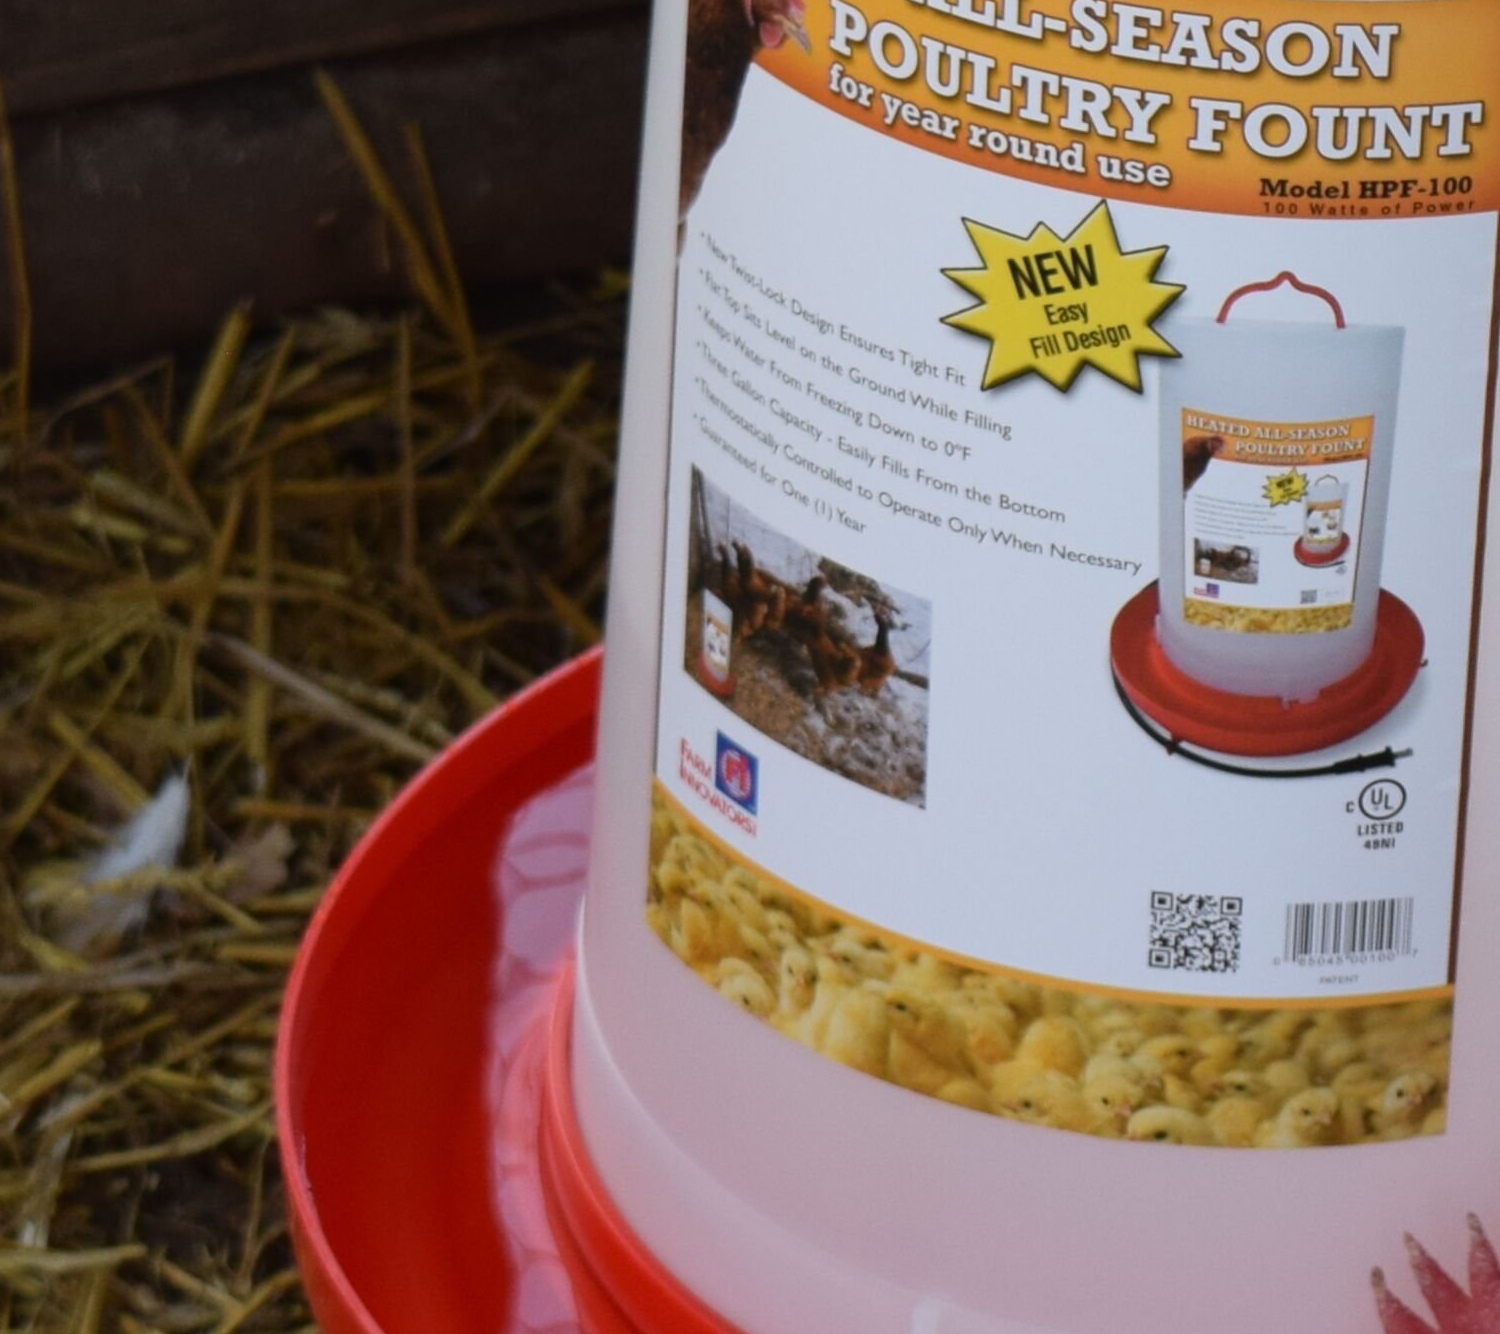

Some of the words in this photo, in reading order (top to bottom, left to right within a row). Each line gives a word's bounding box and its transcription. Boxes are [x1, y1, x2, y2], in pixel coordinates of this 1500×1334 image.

[829, 63, 874, 107] for
[880, 92, 960, 140] year
[968, 124, 1086, 174] round
[1097, 154, 1172, 187] use
[1188, 100, 1484, 161] FOUNT
[1259, 178, 1350, 199] Model
[1358, 176, 1473, 199] HPF-100
[1263, 202, 1298, 215] 100
[1310, 203, 1369, 216] Watts
[1381, 202, 1402, 215] of
[1412, 200, 1477, 214] Power
[1007, 244, 1098, 300] NEW
[1043, 302, 1089, 325] Easy
[723, 286, 741, 315] Top
[766, 320, 796, 349] Level
[800, 345, 817, 362] on
[821, 355, 844, 376] the
[848, 367, 906, 403] Ground
[910, 391, 958, 421] While
[964, 410, 1012, 441] Filling
[730, 254, 787, 307] Twist-Lock
[791, 299, 834, 334] Design
[840, 324, 895, 362] Ensures
[899, 349, 939, 376] Tight
[945, 367, 966, 386] Fit
[1029, 333, 1062, 359] Fill
[1063, 324, 1131, 352] Design
[732, 333, 767, 367] Water
[770, 359, 802, 390] From
[806, 382, 863, 427] Freezing
[868, 412, 915, 443] Down
[921, 436, 938, 452] to
[699, 416, 758, 474] Guaranteed
[760, 464, 777, 485] for
[782, 479, 810, 506] One
[837, 507, 866, 533] Year
[699, 376, 780, 454] Thermostatically
[783, 443, 853, 492] Controlled
[857, 485, 874, 500] to
[878, 491, 942, 527] Operate
[948, 516, 988, 544] Only
[990, 527, 1043, 555] When
[1050, 543, 1142, 576] Necessary
[731, 370, 767, 406] Gallon
[770, 398, 823, 443] Capacity
[837, 435, 877, 468] Easily
[881, 454, 910, 479] Fills
[916, 468, 959, 496] From
[965, 486, 992, 505] the
[999, 493, 1066, 523] Bottom
[1357, 821, 1404, 836] LISTED
